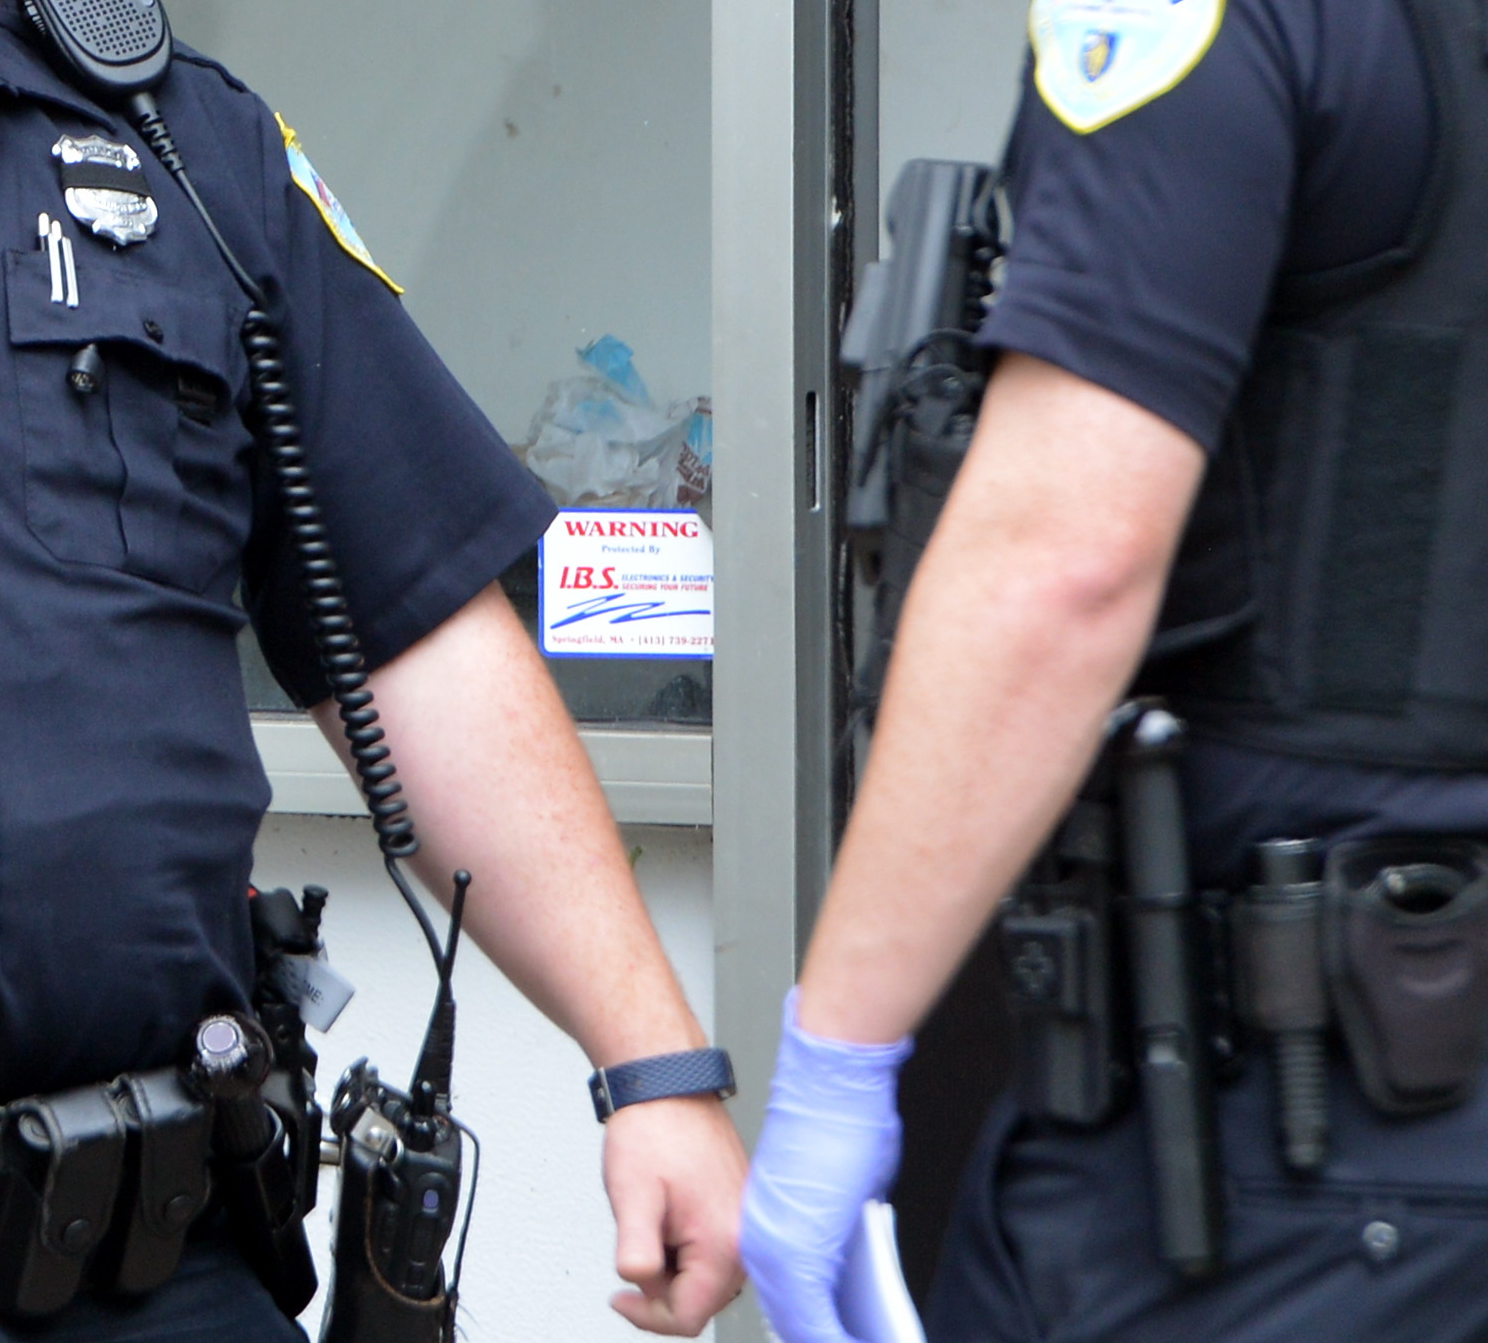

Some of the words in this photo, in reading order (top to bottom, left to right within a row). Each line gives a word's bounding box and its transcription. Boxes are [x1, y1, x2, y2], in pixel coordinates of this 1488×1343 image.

[564, 521, 699, 538] WARNING
[601, 544, 645, 554] Protected
[648, 545, 660, 556] By
[560, 566, 619, 589] I.B.S.
[621, 574, 670, 582] ELECTRONICS
[610, 636, 623, 644] MA
